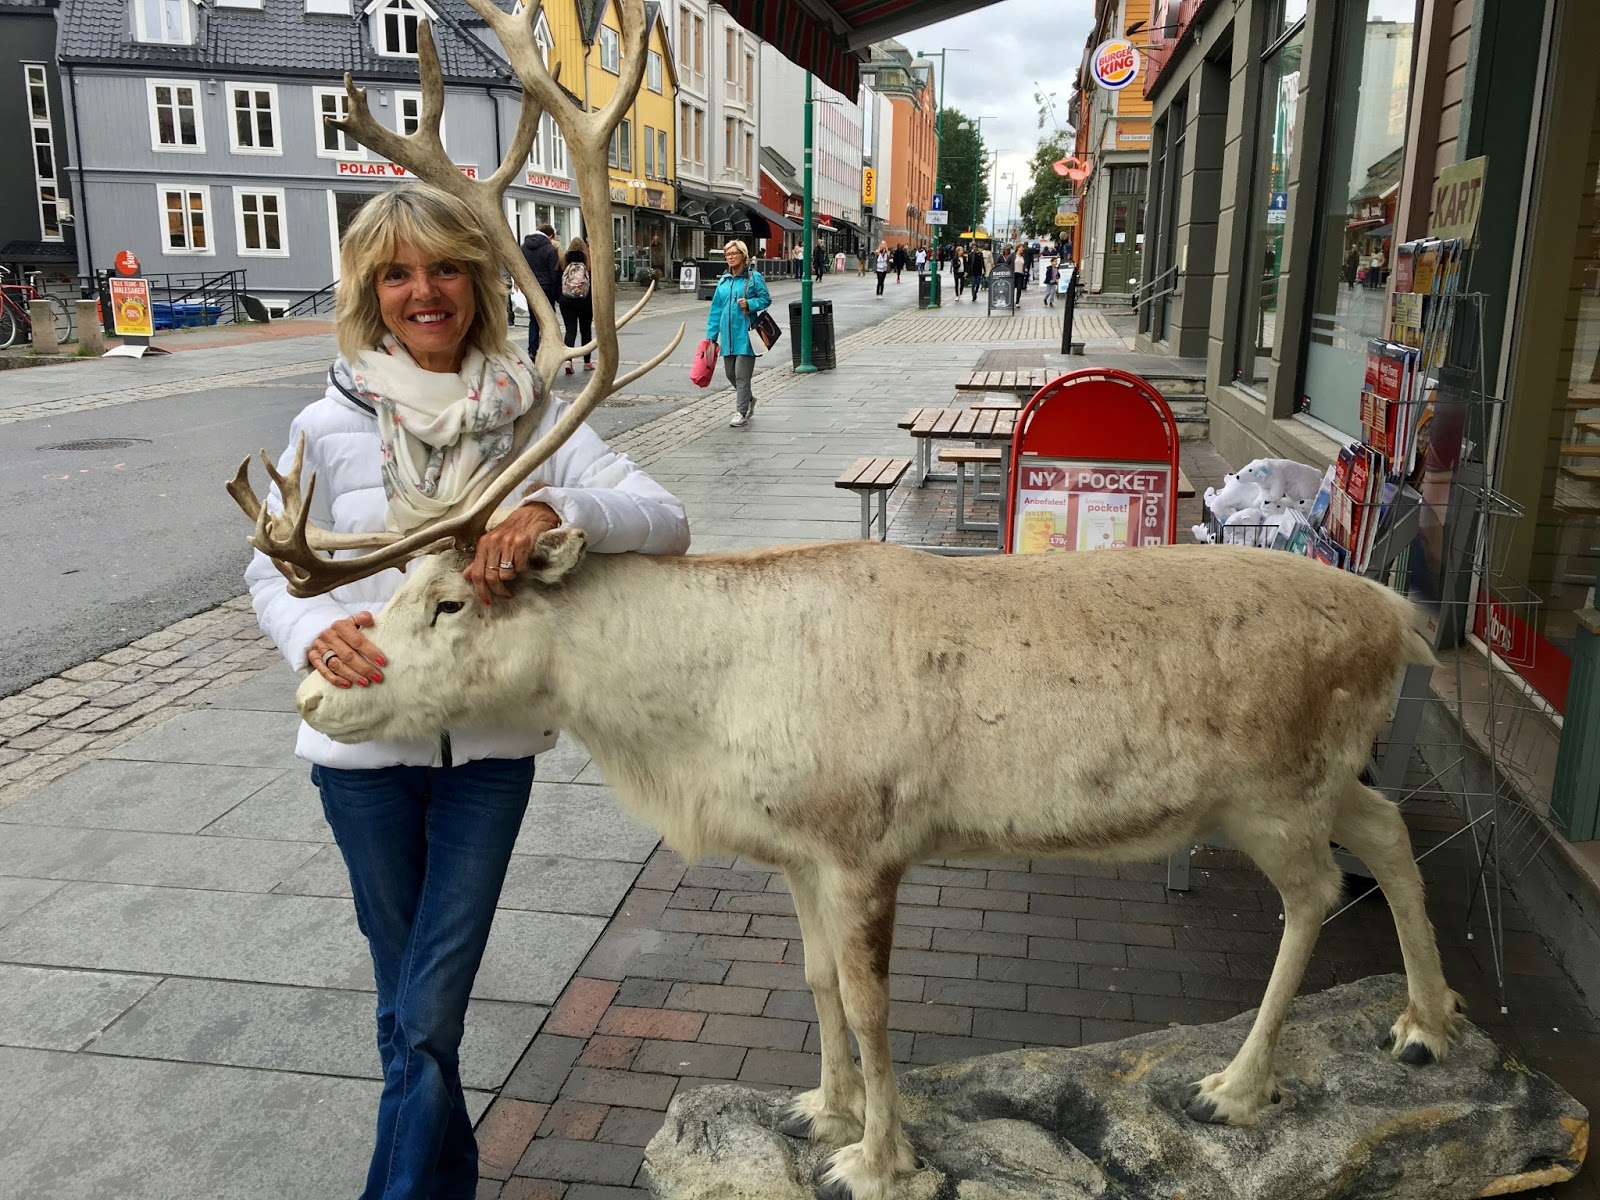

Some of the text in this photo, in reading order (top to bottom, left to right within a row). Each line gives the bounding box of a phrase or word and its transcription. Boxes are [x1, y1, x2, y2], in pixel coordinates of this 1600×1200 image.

[1099, 47, 1132, 66] BURGER
[1100, 56, 1134, 77] KING
[340, 163, 385, 175] POLAR
[528, 174, 543, 185] POLAR
[551, 180, 570, 190] CHARTER
[865, 171, 874, 197] coop
[1432, 177, 1481, 230] KART
[113, 286, 145, 294] MALESAKER
[1029, 471, 1158, 491] NY I POCKET
[1024, 497, 1066, 506] Anbefales!
[1088, 504, 1127, 513] pocket!
[1145, 493, 1163, 528] hos
